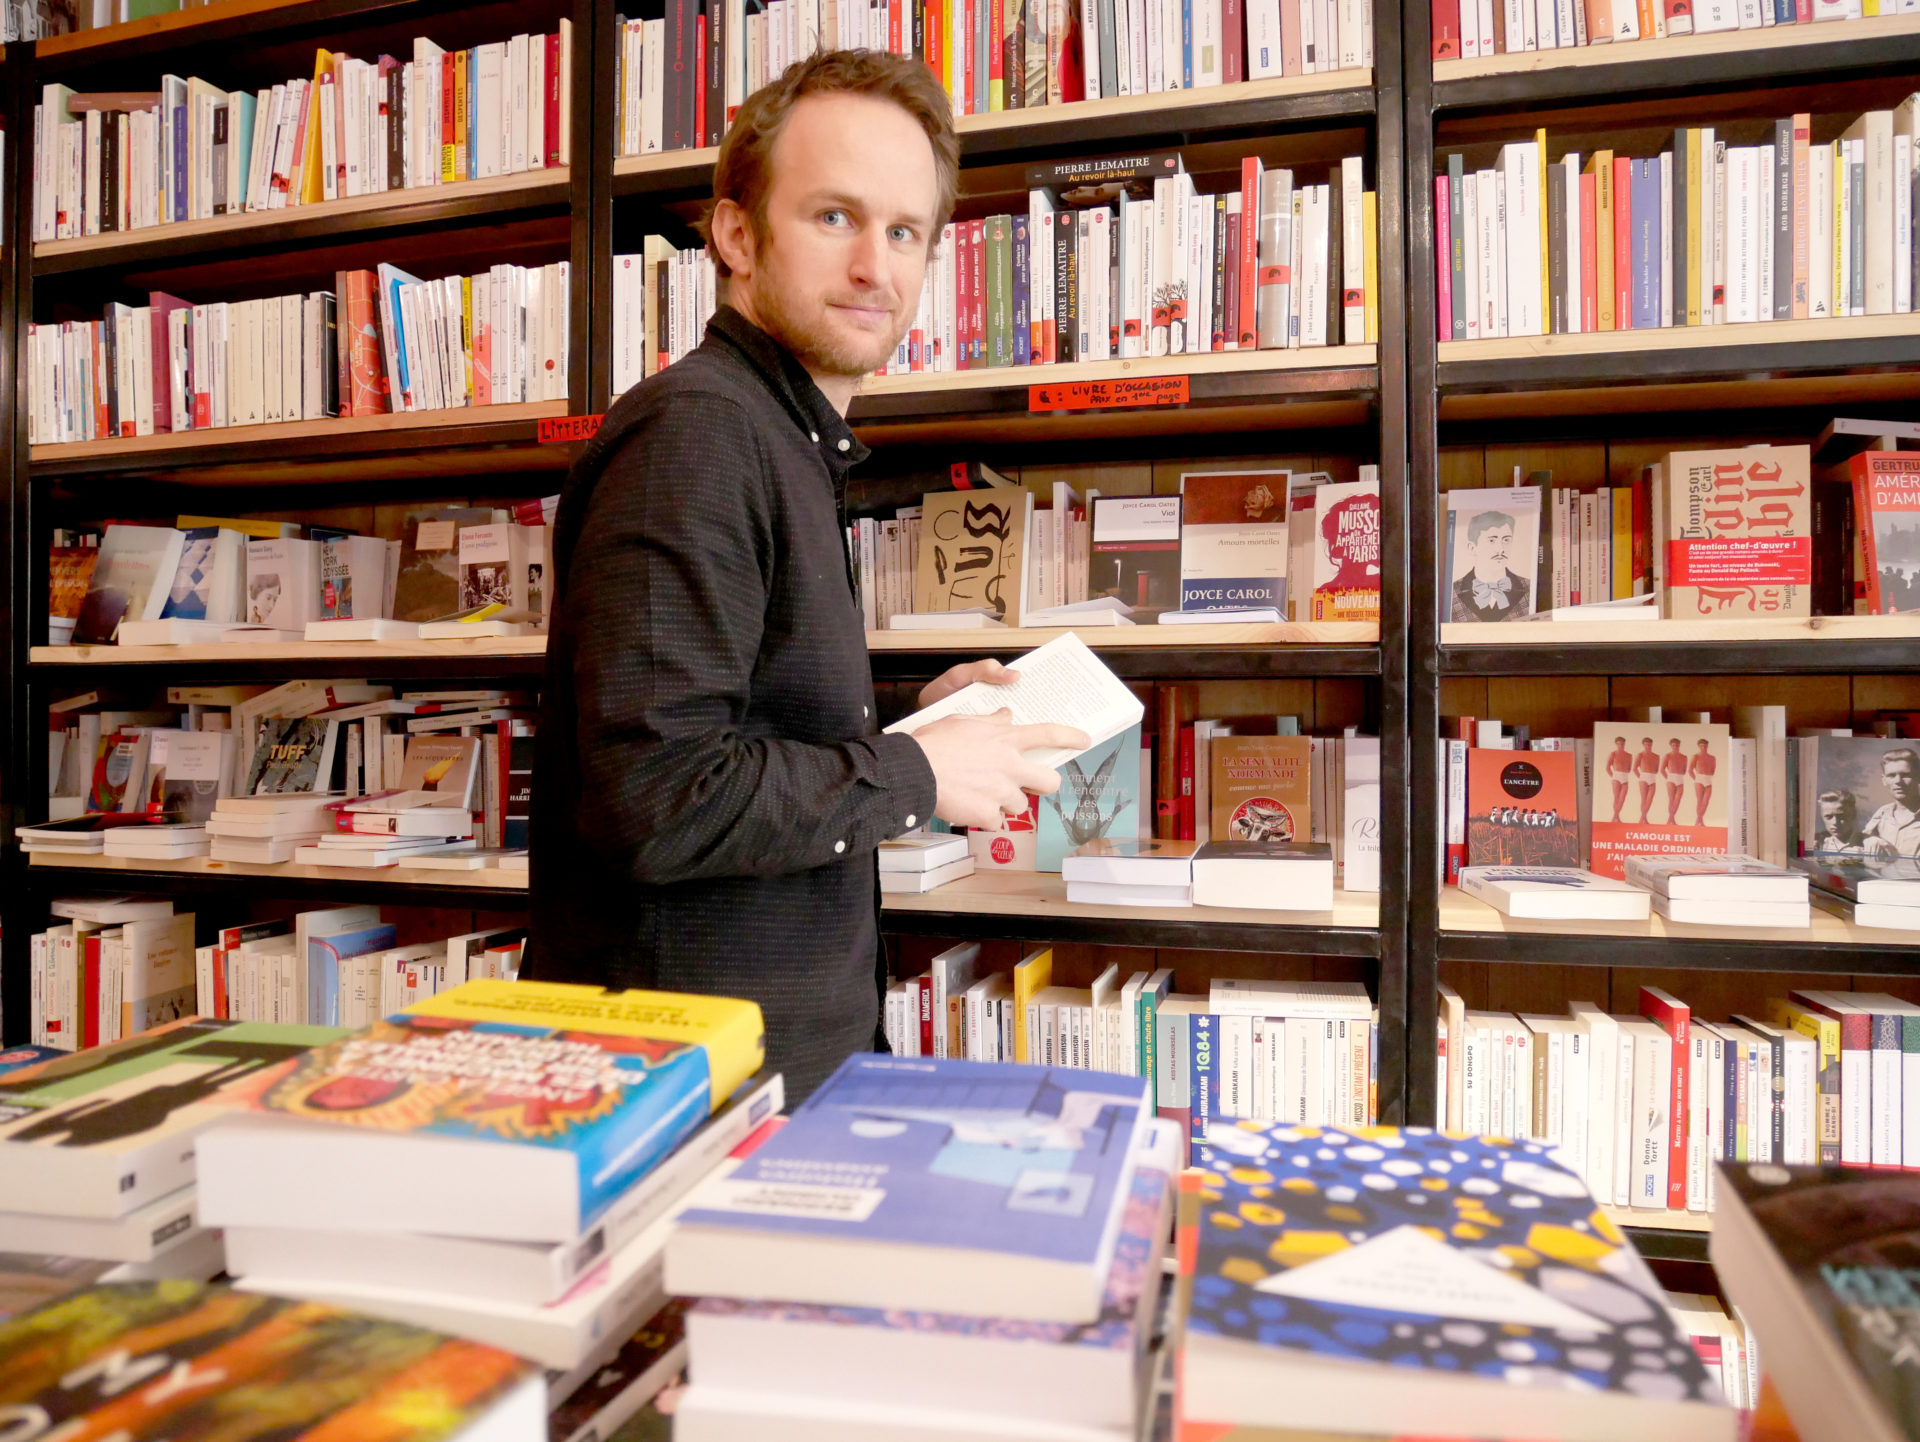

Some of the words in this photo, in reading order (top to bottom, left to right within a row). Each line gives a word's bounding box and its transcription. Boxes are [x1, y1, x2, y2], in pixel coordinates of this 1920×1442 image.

[1780, 130, 1789, 165] Menteur
[1055, 163, 1092, 174] PIERRE
[1094, 157, 1150, 171] LEMAITRE
[1068, 174, 1079, 182] Au
[1107, 169, 1136, 178] là-haut
[1781, 172, 1789, 211] ROBERGE
[1058, 239, 1067, 293] LEMAITRE
[1068, 253, 1076, 281] là-haut
[1068, 283, 1076, 306] revoir
[1058, 297, 1067, 333] PIERRE
[1068, 308, 1076, 318] Au
[1072, 384, 1108, 396] LIVRE
[1156, 393, 1180, 403] page
[1336, 532, 1380, 547] APPARTEME
[1730, 542, 1790, 550] chef-d'œuvre
[322, 555, 338, 565] YORK
[1349, 545, 1377, 563] PARIS
[322, 563, 349, 578] ODYSSÉE
[1184, 590, 1223, 603] JOYCE
[1227, 589, 1272, 599] CAROL
[270, 744, 307, 760] TUFF
[1227, 768, 1297, 779] NORMANDE
[1504, 778, 1540, 786] L'ANCÊTRE
[1626, 832, 1671, 841] L'AMOUR
[1615, 843, 1658, 852] MALADIE
[1662, 845, 1717, 855] ORDINAIRE
[921, 988, 931, 1021] UNAMERICA
[1144, 1006, 1152, 1022] libre
[1144, 1024, 1152, 1044] chute
[1060, 1034, 1068, 1065] MORRISON
[1072, 1035, 1080, 1066] MORRISON
[1146, 1045, 1152, 1054] en
[1197, 1031, 1210, 1072] 1Q84
[1352, 1045, 1364, 1071] PRÉSENT
[1144, 1055, 1153, 1084] auvage
[1200, 1076, 1209, 1116] MURAKAMI
[1354, 1103, 1363, 1122] MUSSO
[1646, 1174, 1654, 1197] POCKET
